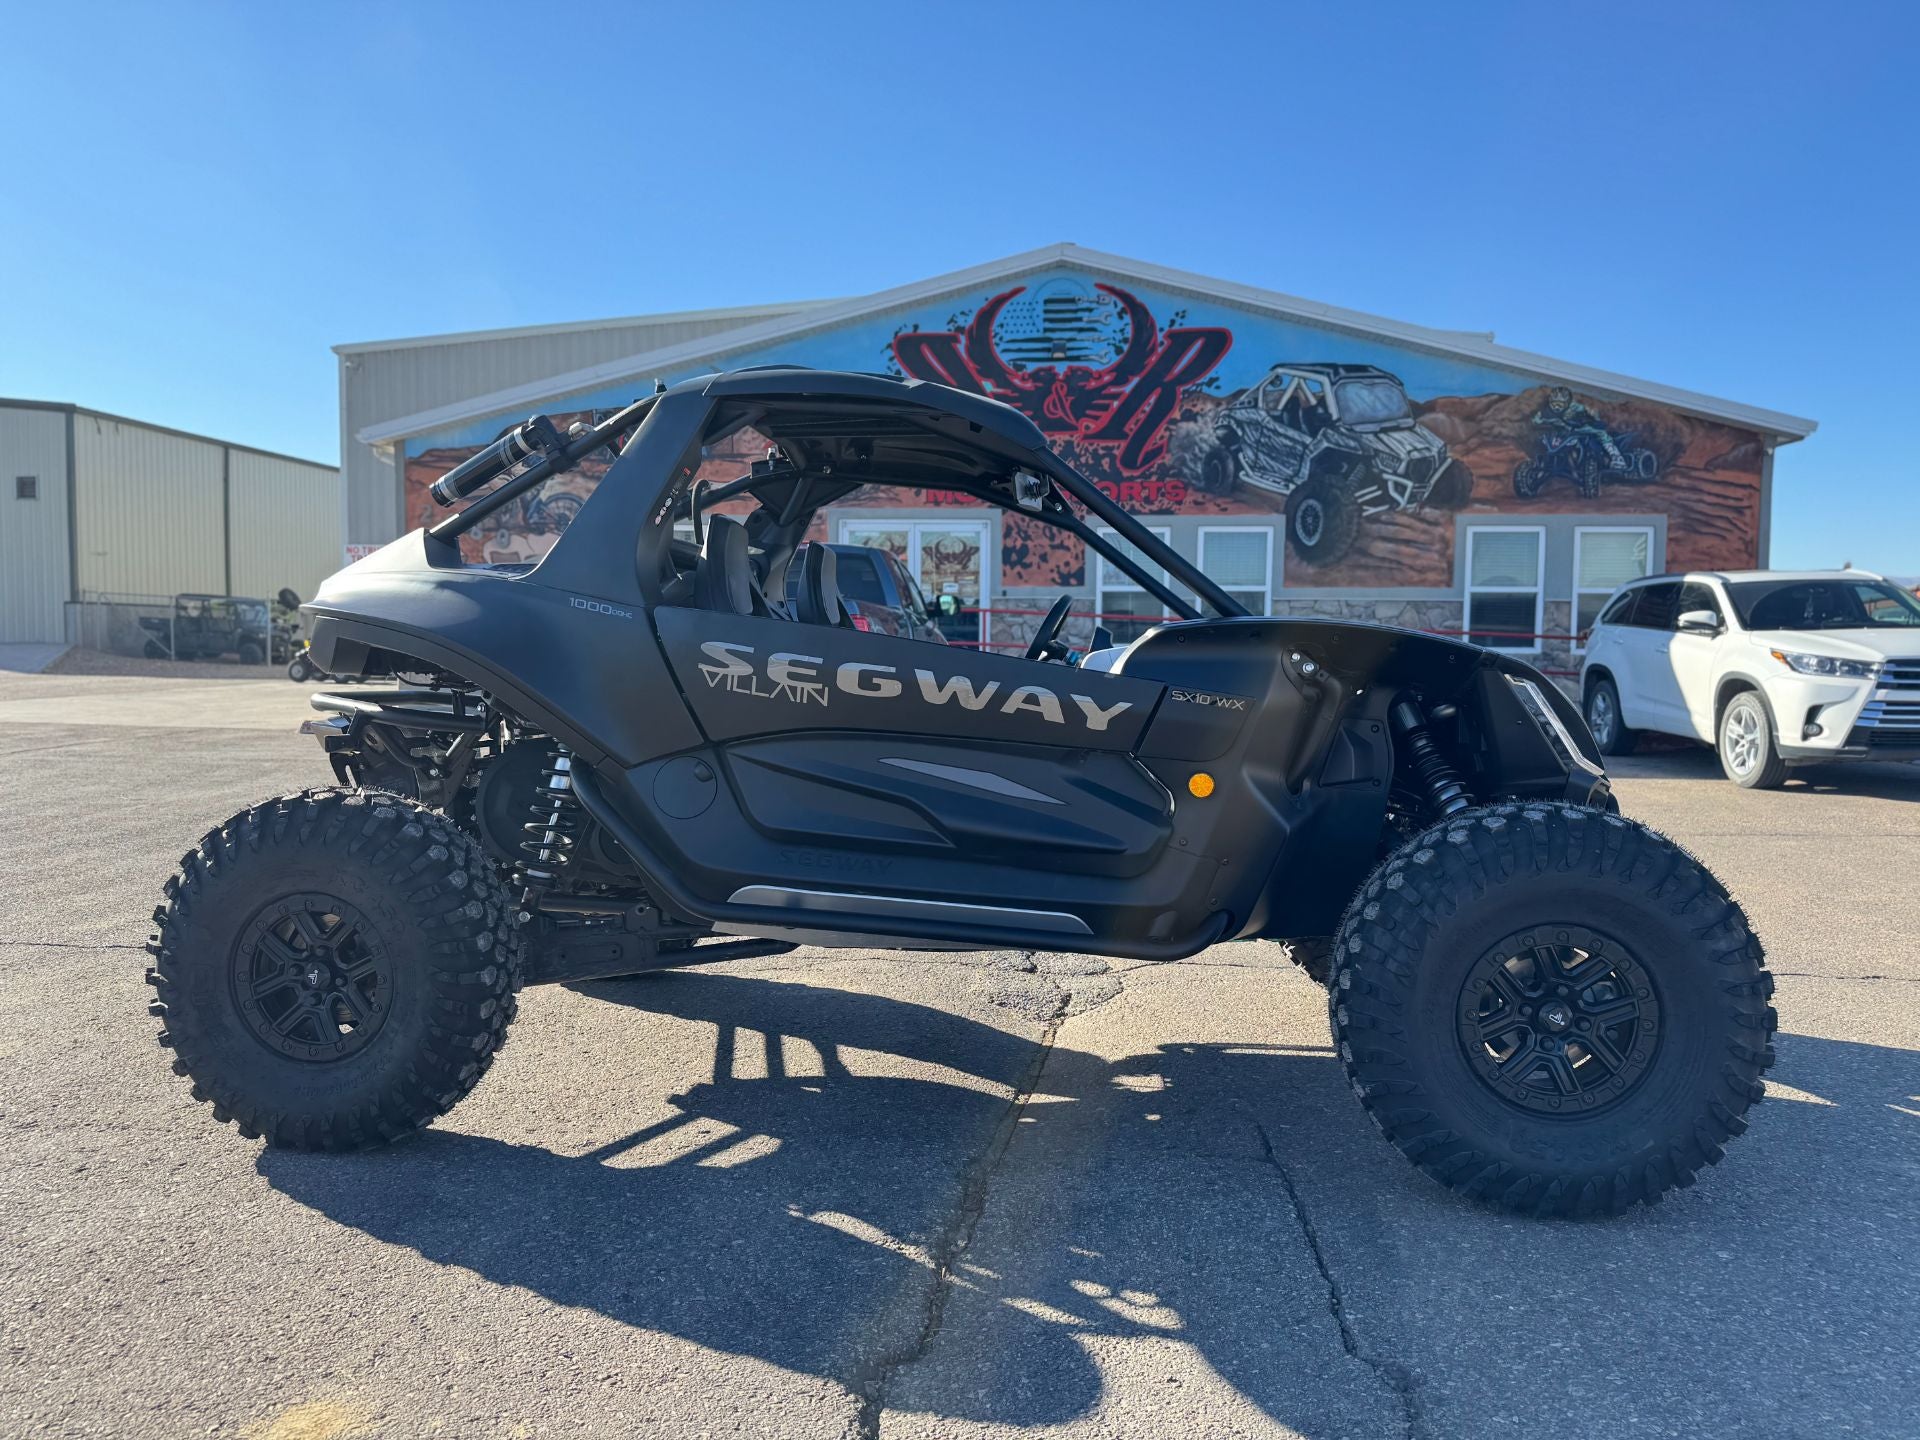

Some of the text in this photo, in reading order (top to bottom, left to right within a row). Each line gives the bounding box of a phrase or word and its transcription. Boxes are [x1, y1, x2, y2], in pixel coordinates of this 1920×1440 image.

[698, 641, 1134, 731] SEGWAY
[700, 666, 829, 707] VILLAIN
[1171, 690, 1246, 711] SX10 WX
